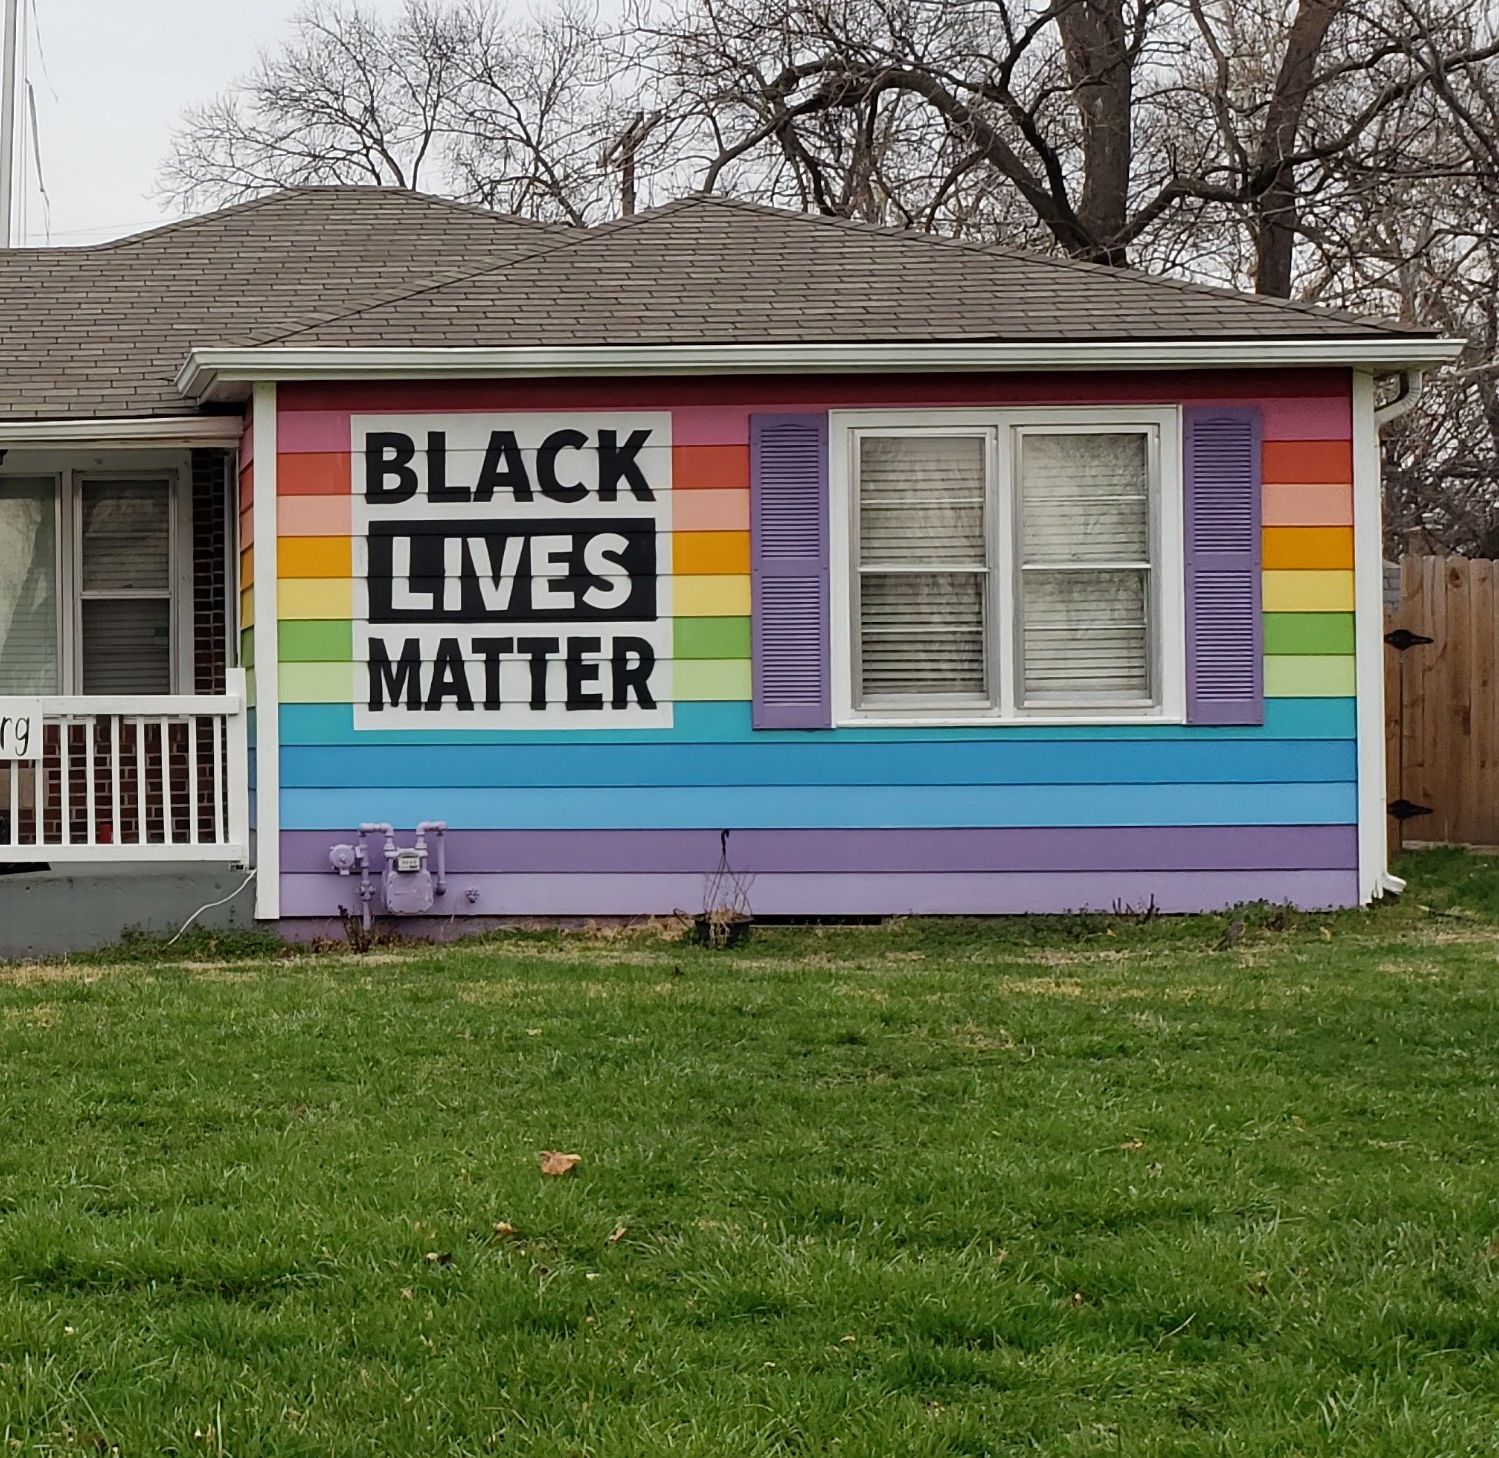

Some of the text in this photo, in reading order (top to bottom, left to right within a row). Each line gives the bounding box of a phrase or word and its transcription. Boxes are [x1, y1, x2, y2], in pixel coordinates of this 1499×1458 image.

[365, 428, 657, 505] BLACK
[391, 532, 633, 611] LIVES
[368, 636, 658, 712] MATTER
